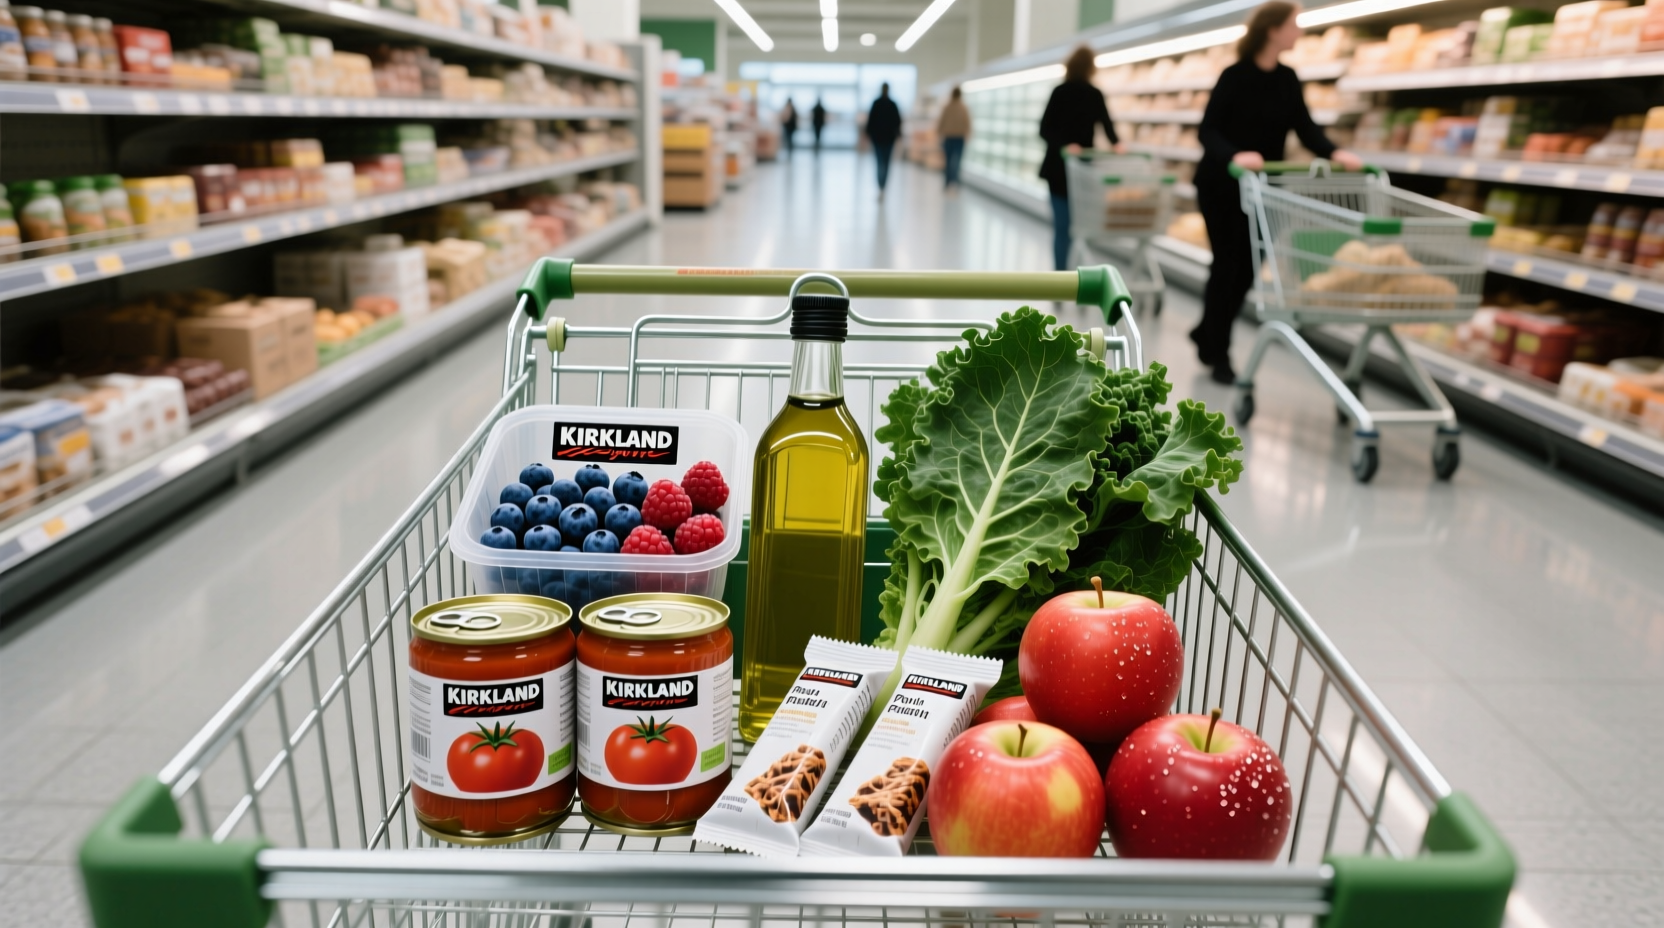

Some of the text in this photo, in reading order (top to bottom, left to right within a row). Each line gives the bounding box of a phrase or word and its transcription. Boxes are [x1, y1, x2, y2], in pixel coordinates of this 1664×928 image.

[560, 426, 673, 449] KIRKLAND
[447, 683, 540, 705] KIRKLAND
[606, 679, 694, 698] KIRKLAND
